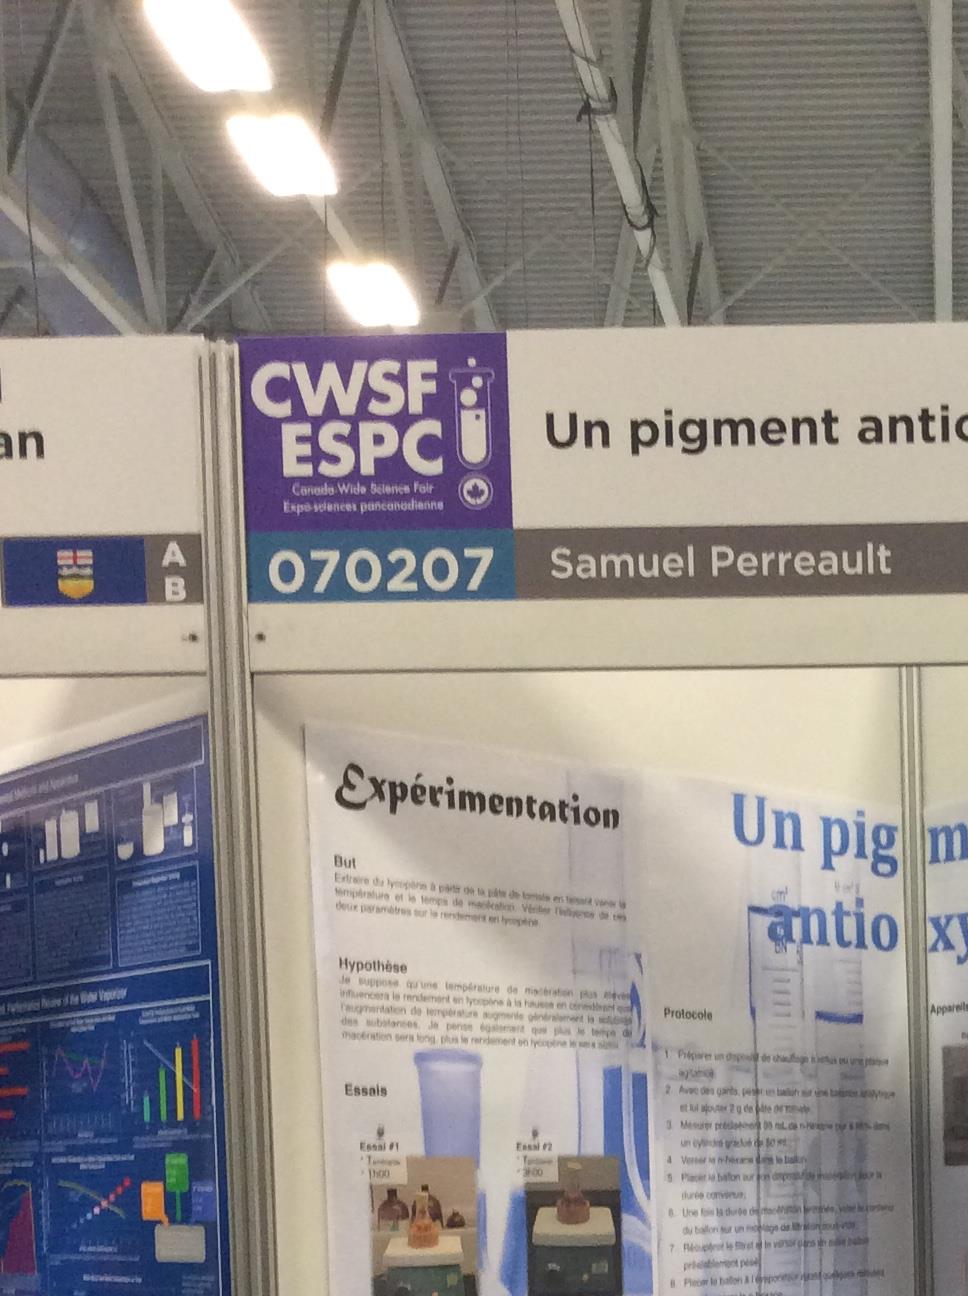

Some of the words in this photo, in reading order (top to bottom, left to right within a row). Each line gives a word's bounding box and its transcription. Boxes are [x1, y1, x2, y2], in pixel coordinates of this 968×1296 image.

[250, 358, 438, 419] CWSF
[281, 418, 443, 478] ESPC
[545, 410, 611, 450] Un
[629, 408, 840, 456] pigment
[370, 482, 411, 496] Science
[413, 480, 435, 495] Fair
[267, 547, 495, 595] 070207
[549, 544, 694, 580] Samuel
[710, 542, 892, 578] Perreault
[334, 762, 620, 831] Expérimentation
[731, 791, 804, 853] Un
[819, 809, 899, 879] pig
[334, 854, 356, 870] But
[766, 895, 899, 954] antio
[339, 956, 408, 974] Hypothèse
[664, 1007, 713, 1021] Protocole
[345, 1083, 387, 1097] Essais
